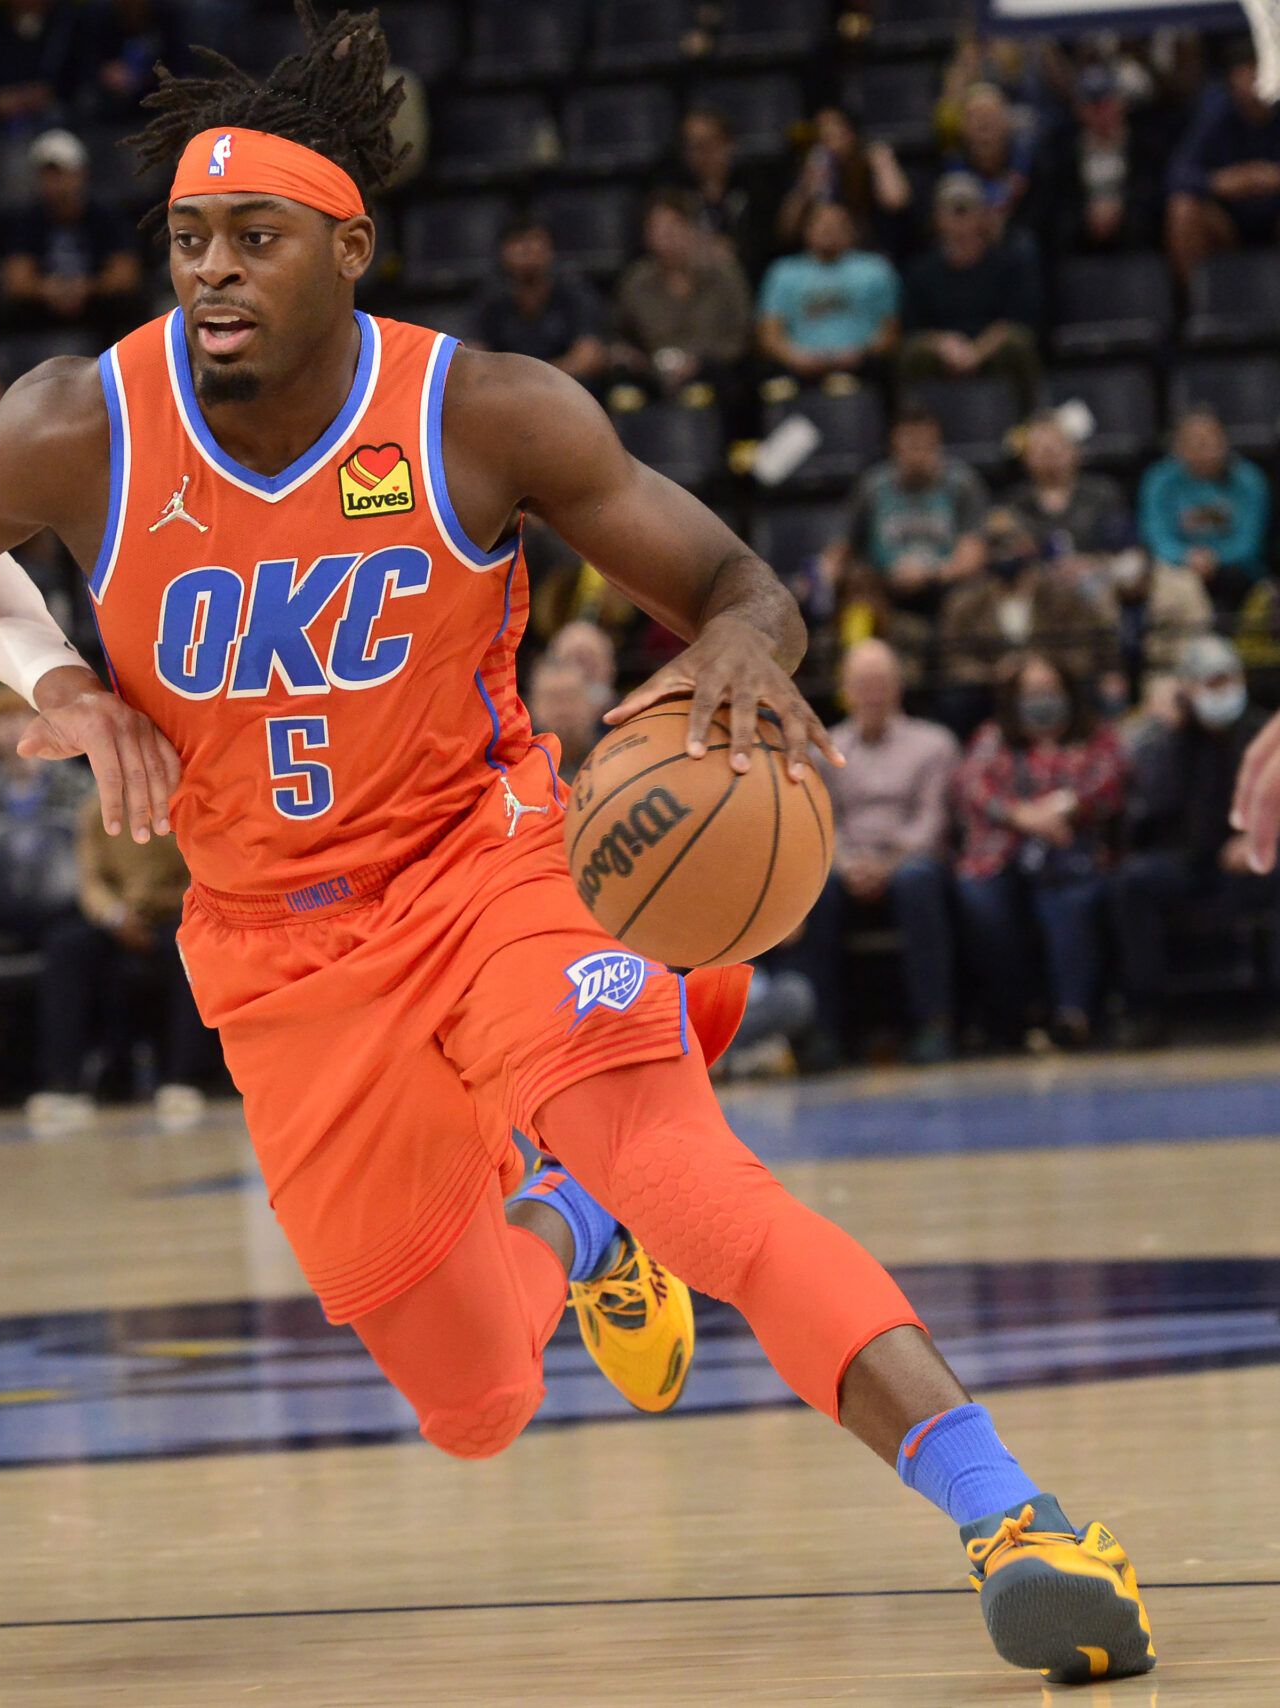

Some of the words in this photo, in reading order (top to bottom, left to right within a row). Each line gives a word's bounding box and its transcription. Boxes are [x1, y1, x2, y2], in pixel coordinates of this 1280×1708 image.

[153, 544, 433, 701] OKC
[265, 715, 335, 821] 5
[577, 960, 631, 1010] OKC
